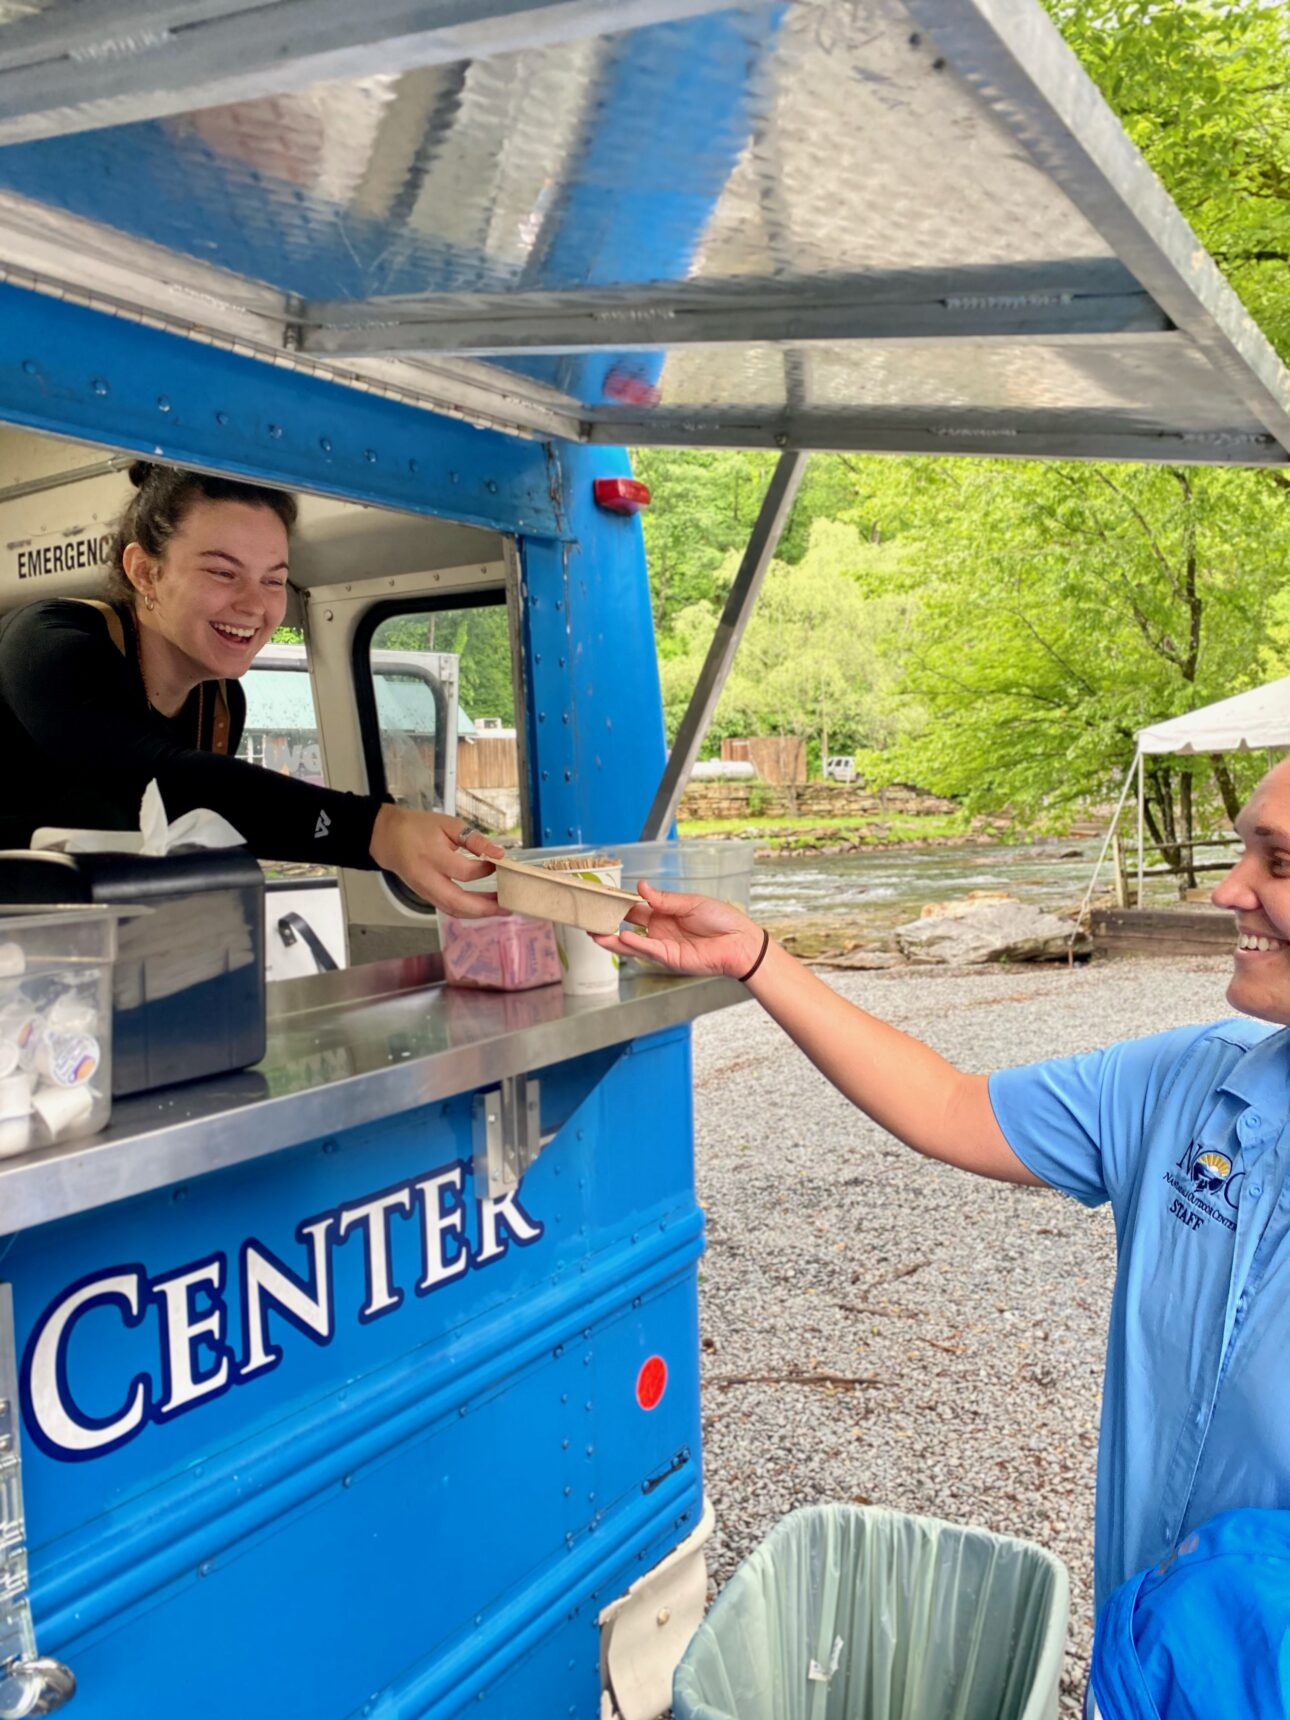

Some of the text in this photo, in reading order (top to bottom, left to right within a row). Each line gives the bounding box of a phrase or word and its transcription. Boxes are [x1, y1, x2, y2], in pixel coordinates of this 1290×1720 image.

[18, 534, 116, 579] EMERGENC
[1170, 1199, 1204, 1231] STAFF
[21, 1158, 545, 1461] CENTER
